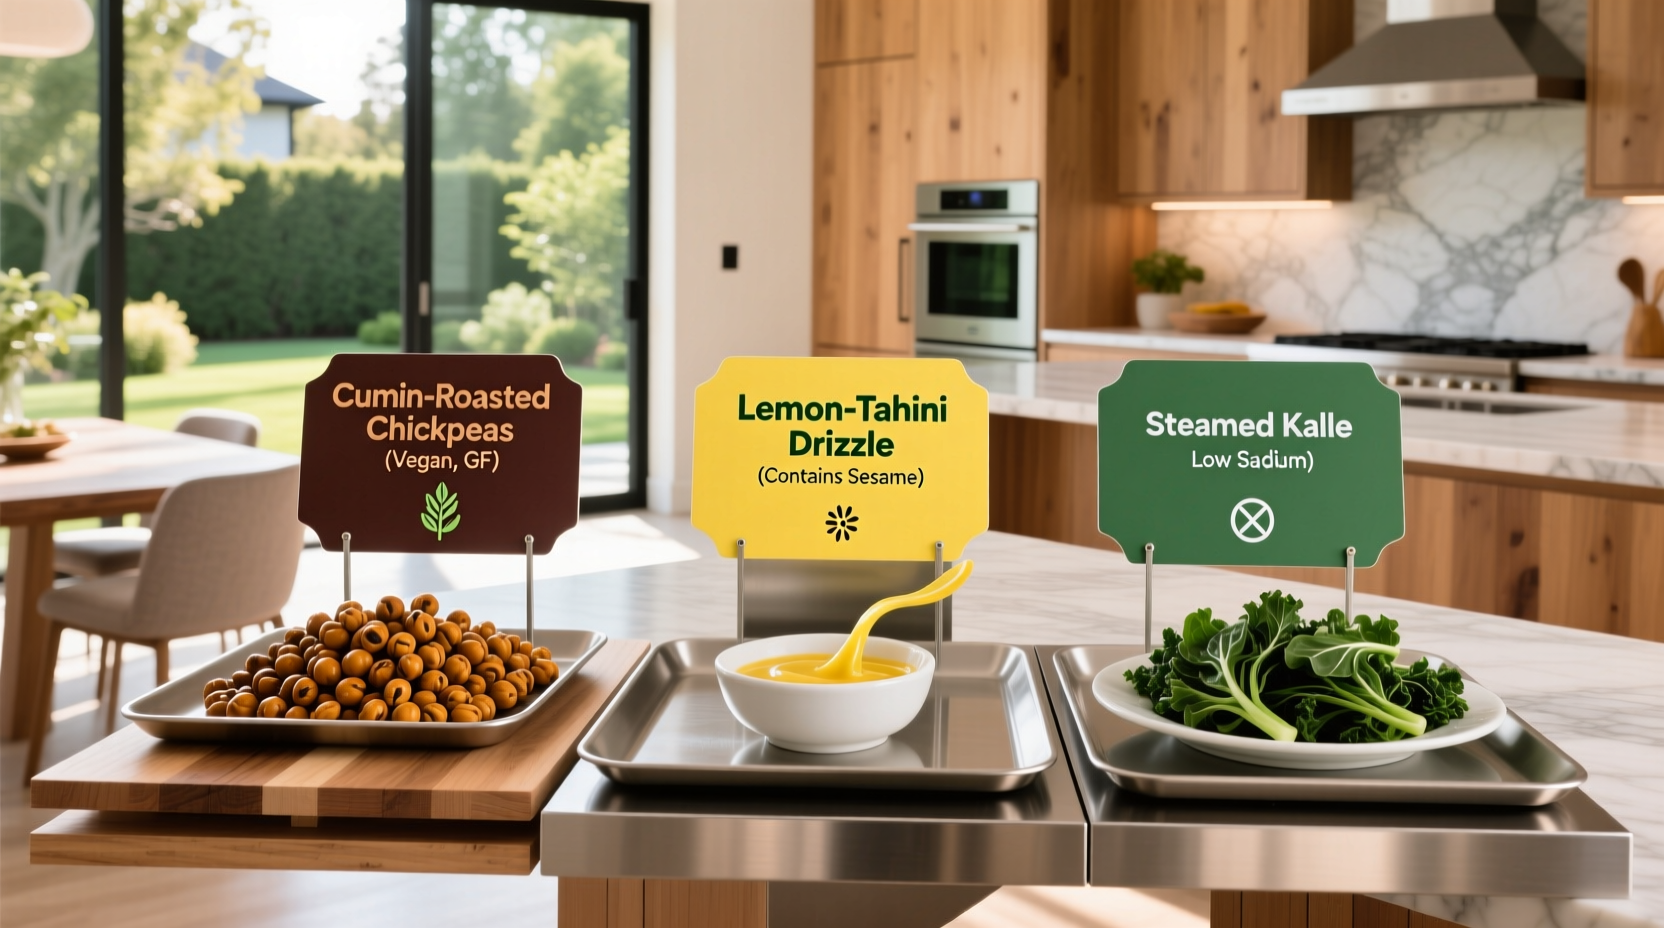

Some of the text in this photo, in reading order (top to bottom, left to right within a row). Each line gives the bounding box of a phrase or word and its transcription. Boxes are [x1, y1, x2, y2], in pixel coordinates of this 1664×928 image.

[333, 382, 551, 410] Cumin-Roasted
[738, 394, 947, 422] Lemon-Tahini
[367, 415, 514, 448] Chickpeas
[1146, 411, 1353, 438] Steamed Kalle
[789, 429, 895, 457] Drizzle
[385, 450, 500, 473] (Vegan, GF)
[1192, 450, 1232, 468] Low
[758, 466, 924, 488] (Contains Sesame)
